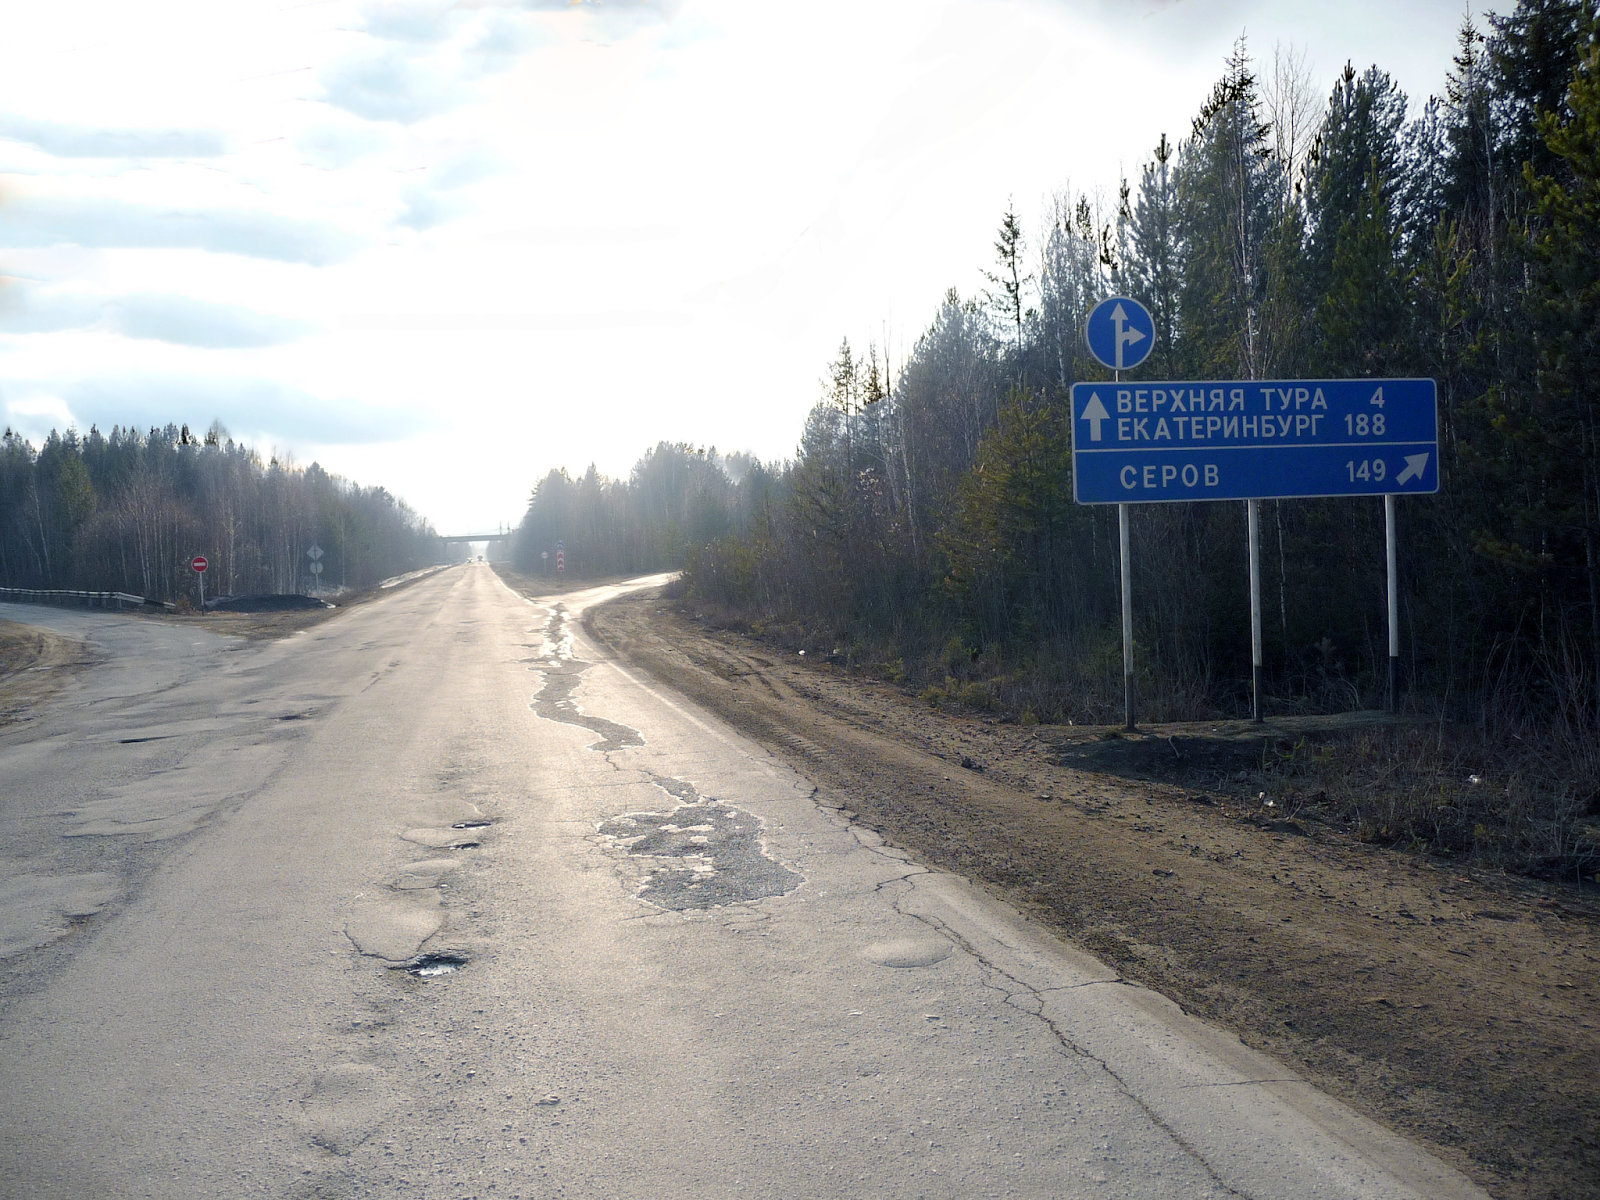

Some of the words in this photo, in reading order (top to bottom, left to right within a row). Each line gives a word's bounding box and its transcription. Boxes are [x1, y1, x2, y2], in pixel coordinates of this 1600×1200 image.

[1117, 388, 1245, 413] ВЕРХНЯЯ
[1260, 387, 1328, 411] ТУРА
[1370, 386, 1385, 409] 4
[1117, 414, 1324, 441] ЕКАТЕРИНБУРГ
[1344, 413, 1386, 436] 188
[1120, 463, 1220, 490] СЕРОВ
[1345, 458, 1387, 483] 149
